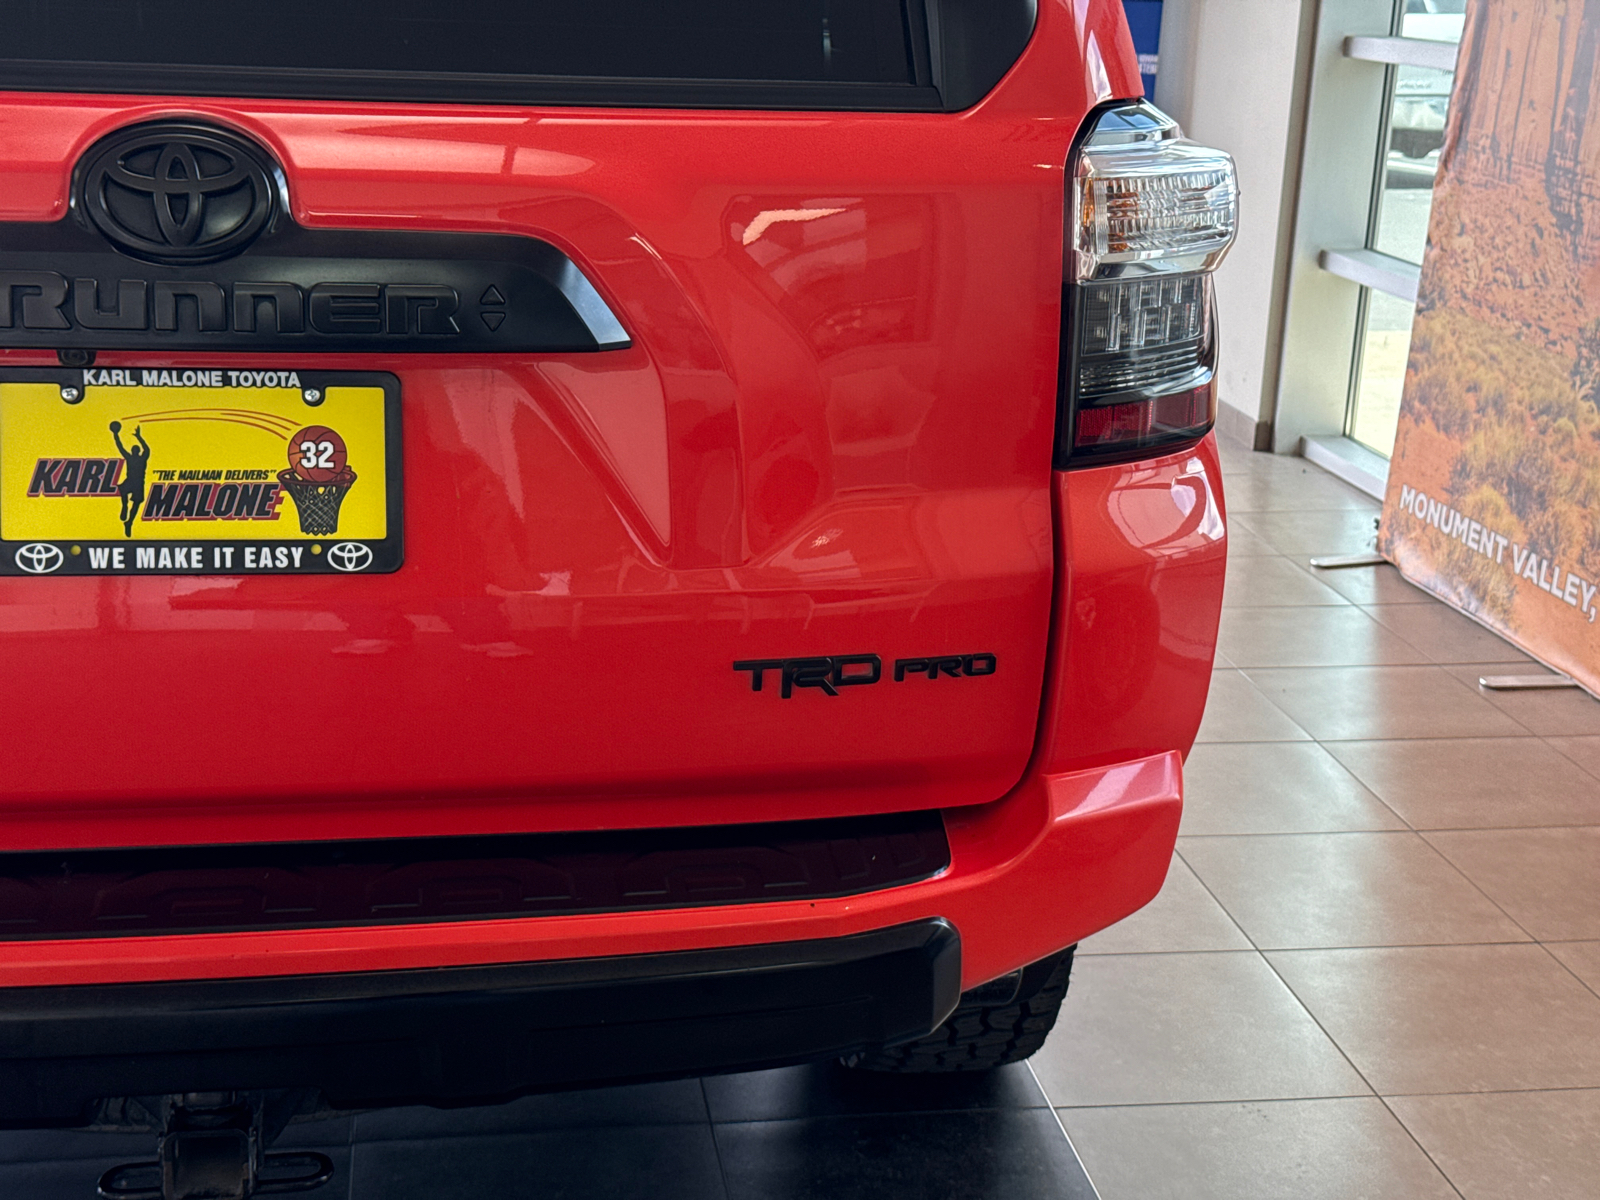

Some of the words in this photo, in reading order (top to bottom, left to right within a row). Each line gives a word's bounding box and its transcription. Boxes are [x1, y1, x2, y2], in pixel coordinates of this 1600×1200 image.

[82, 369, 137, 386] KARL
[141, 370, 223, 387] MALONE
[227, 371, 301, 388] TOYOTA
[299, 441, 335, 468] 32
[28, 458, 122, 496] KARL
[178, 469, 223, 481] MAILMAN
[143, 483, 282, 519] MALONE
[88, 547, 126, 569] WE
[136, 547, 203, 569] MAKE
[214, 547, 236, 568] IT
[245, 546, 304, 568] EASY
[1399, 483, 1508, 564] MONUMENT
[1512, 542, 1597, 623] VALLEY,
[733, 653, 881, 699] TRD
[894, 653, 997, 682] PRO
